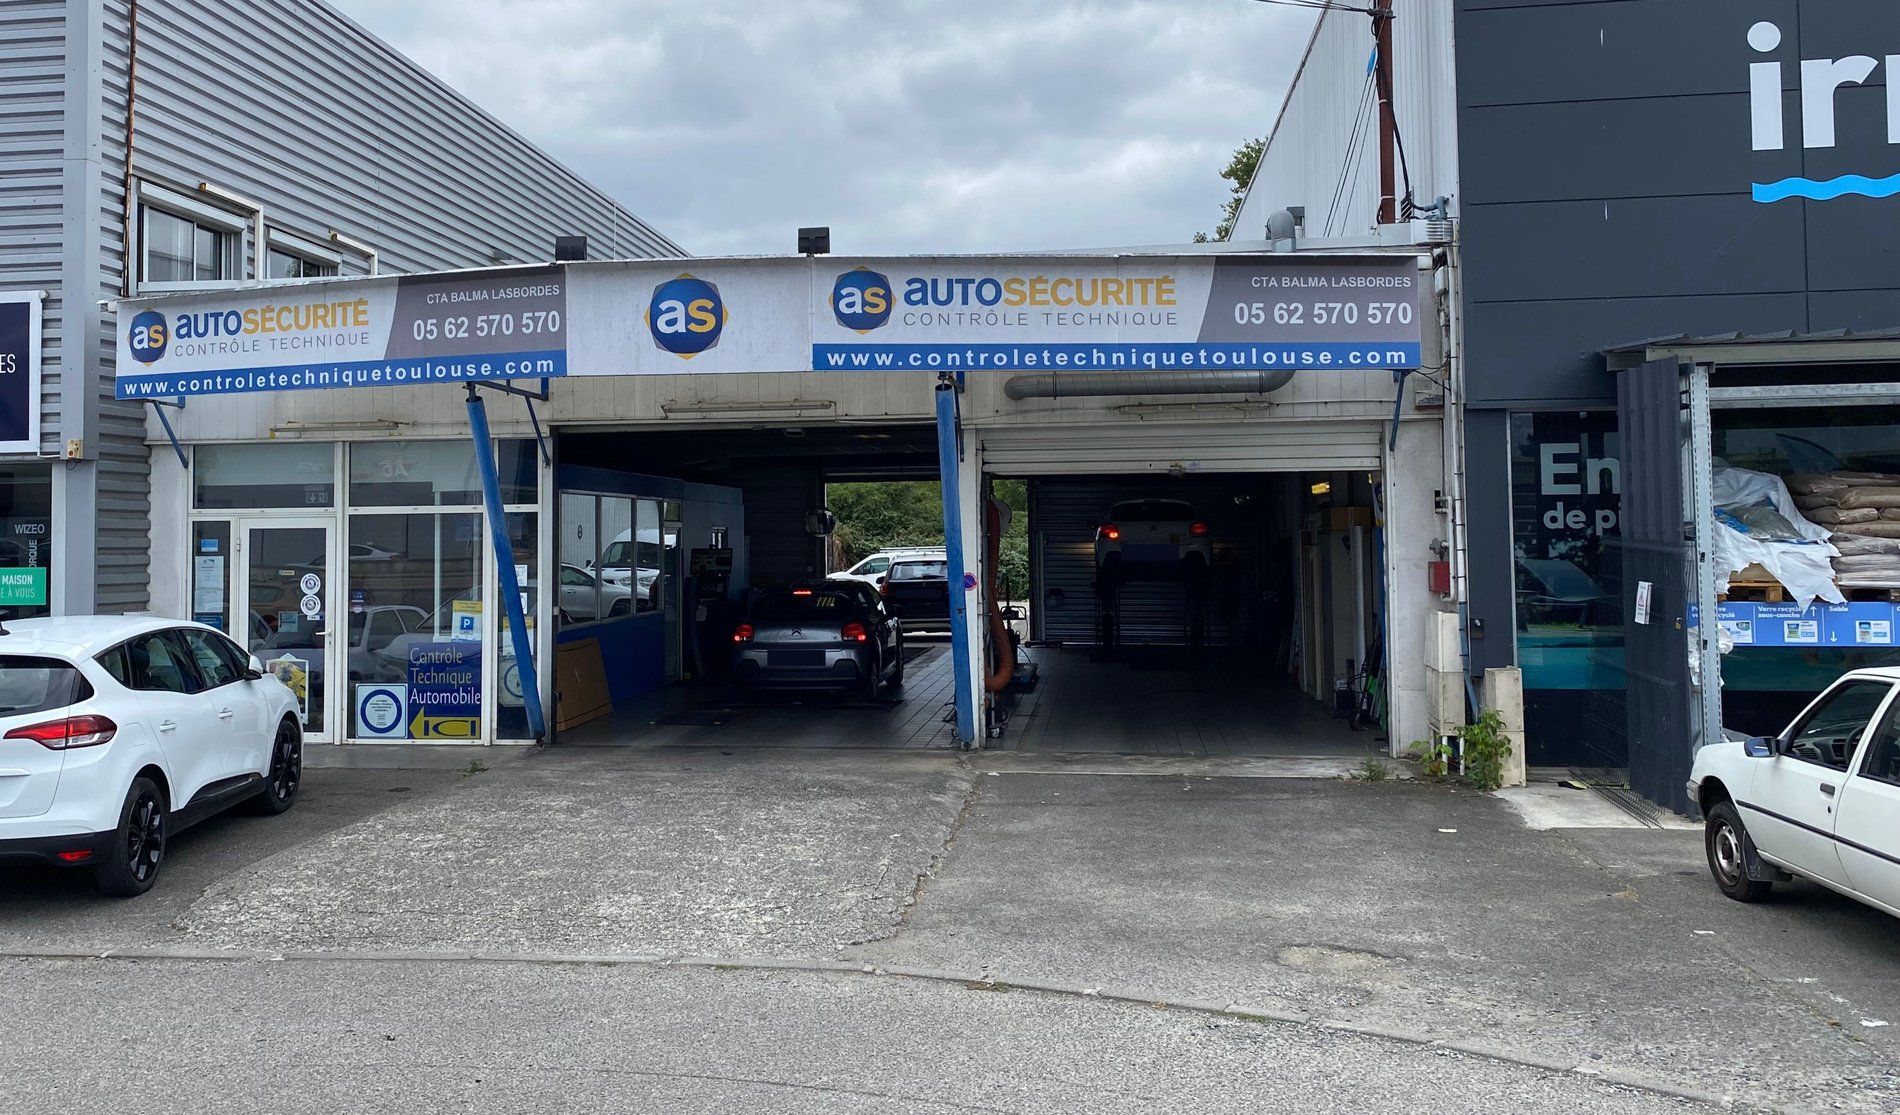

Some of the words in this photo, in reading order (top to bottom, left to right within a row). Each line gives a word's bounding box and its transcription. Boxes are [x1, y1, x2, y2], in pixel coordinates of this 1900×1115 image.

[1251, 276, 1277, 288] CTA
[1282, 276, 1328, 288] BALMA
[1332, 276, 1411, 288] LASBORDES
[427, 292, 448, 304] CTA
[451, 290, 488, 303] BALMA
[492, 284, 560, 299] LASBORDES
[838, 286, 886, 314] as
[656, 298, 716, 334] as
[904, 309, 1028, 326] CONTRÔLE
[1042, 312, 1177, 326] TECHNIQUE
[1234, 302, 1265, 324] 05
[1274, 302, 1304, 324] 62
[1313, 302, 1358, 324] 570
[1368, 302, 1412, 324] 570
[413, 319, 438, 340] 05
[444, 316, 468, 338] 62
[476, 314, 514, 336] 570
[521, 310, 560, 334] 570
[132, 324, 164, 350] as
[175, 338, 260, 357] CONTRÔLE
[270, 332, 369, 350] TECHNIQUE
[827, 348, 1406, 369] www.controletechniquetoulouse.com
[125, 359, 554, 394] www.controletechniquetoulouse.com
[1540, 443, 1620, 495] En
[14, 524, 45, 534] WIZEO
[1543, 501, 1586, 529] de
[1595, 501, 1621, 536] p
[2, 574, 32, 585] MAISON
[8, 584, 12, 598] À
[15, 588, 35, 598] VOUS
[463, 618, 470, 628] P
[410, 646, 462, 664] Contrôle
[410, 668, 472, 689] Technique
[410, 687, 481, 704] Automobile
[424, 720, 476, 736] ICI
